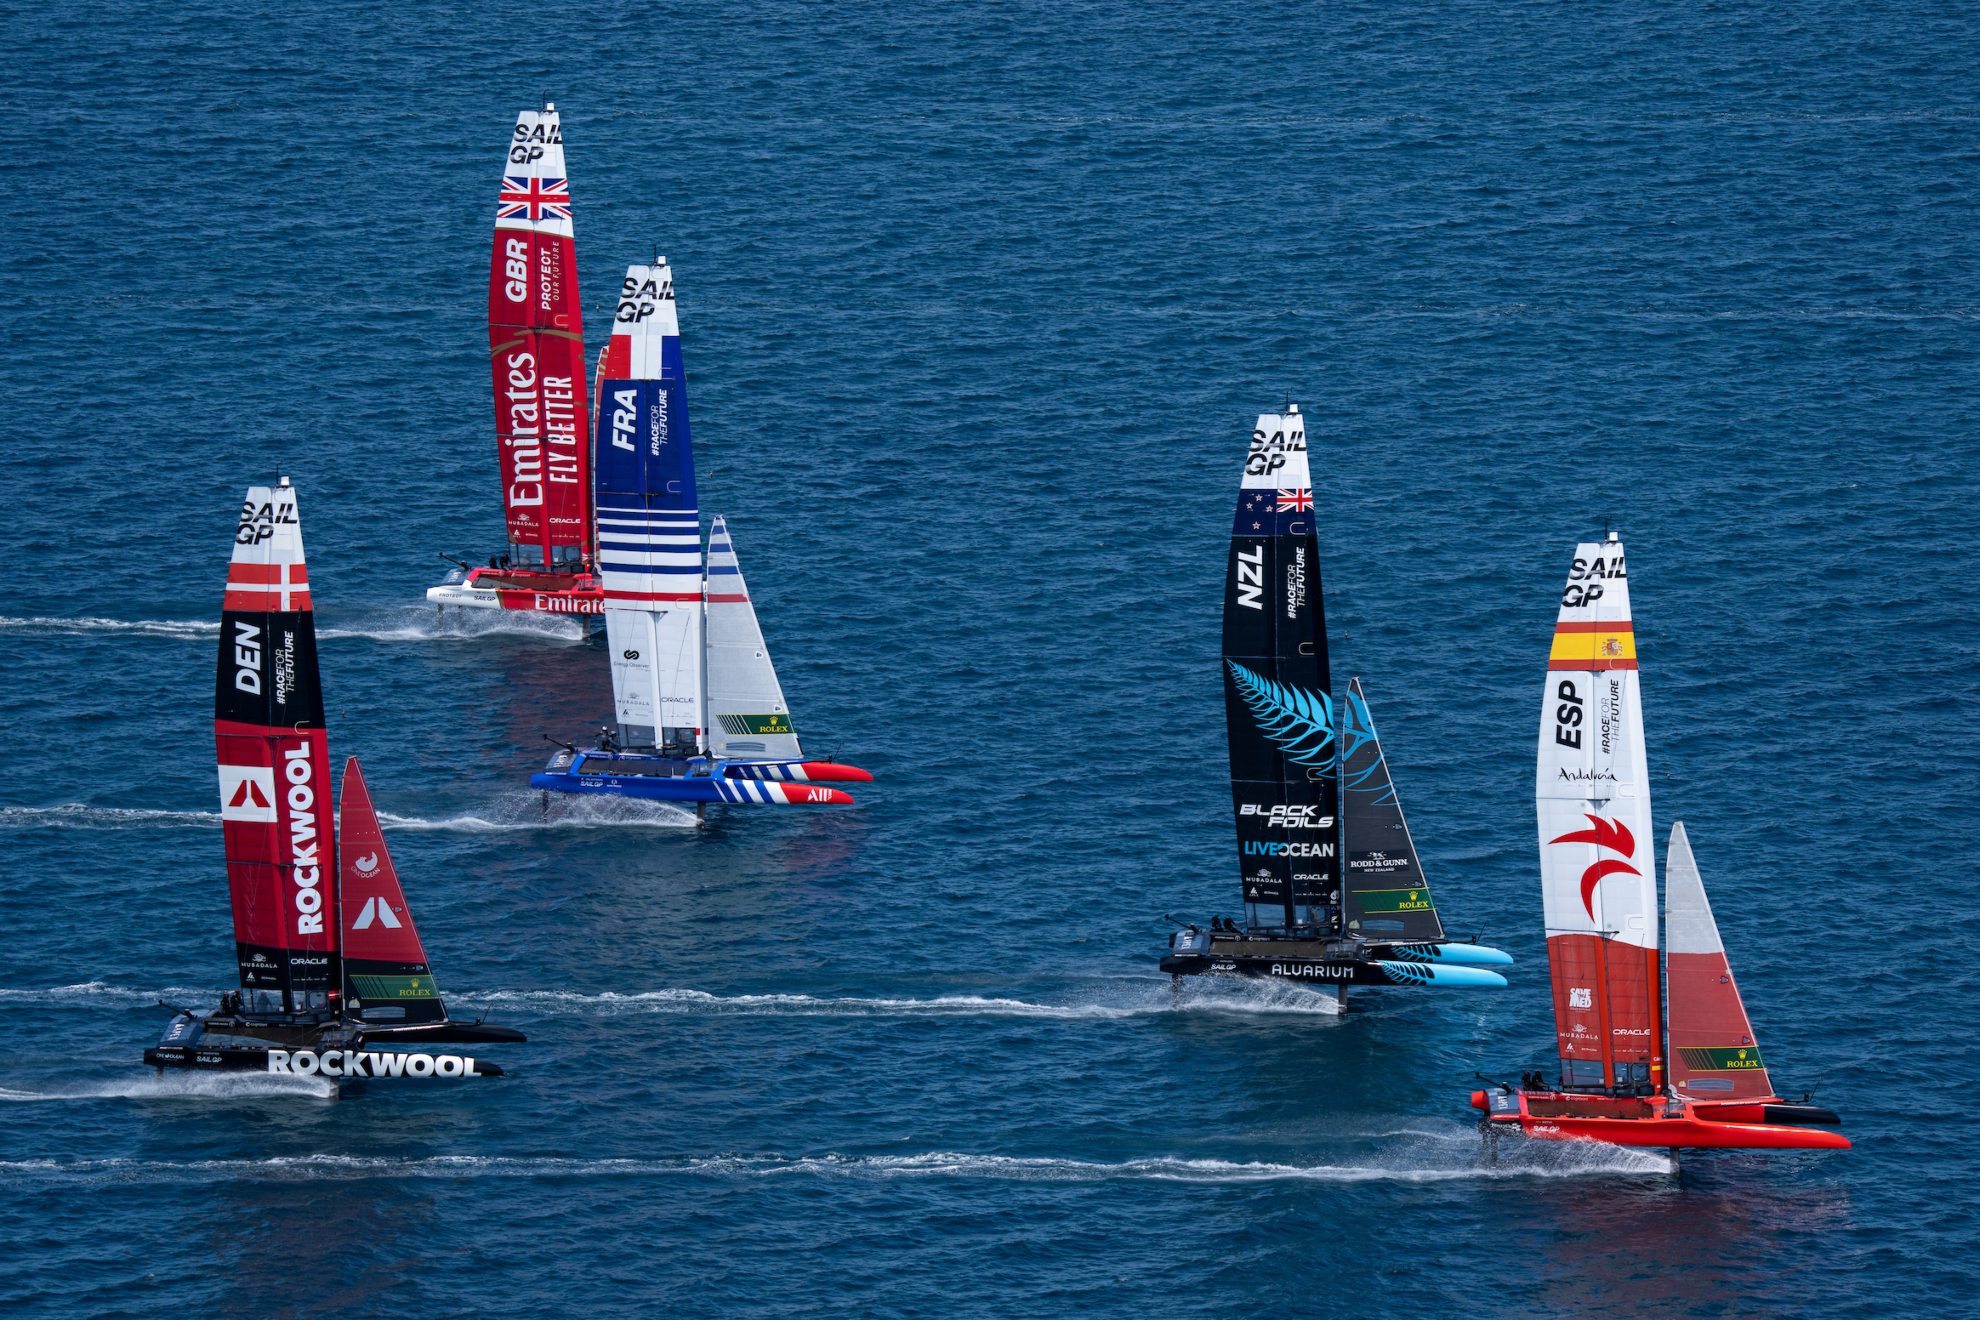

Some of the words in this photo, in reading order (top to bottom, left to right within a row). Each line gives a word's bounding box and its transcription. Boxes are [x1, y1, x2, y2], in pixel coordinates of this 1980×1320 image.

[514, 124, 563, 145] SAIL
[509, 145, 544, 164] GP
[505, 238, 528, 302] GBR
[541, 247, 552, 310] PROTECT
[620, 277, 675, 300] SAIL
[616, 301, 655, 323] GP
[543, 376, 576, 446] BETTER
[612, 389, 637, 452] FRA
[504, 352, 544, 509] Emirates
[1249, 429, 1307, 452] SAIL
[548, 451, 579, 484] FLY
[1245, 453, 1286, 476] GP
[240, 501, 298, 524] SAIL
[236, 523, 274, 545] GP
[1237, 545, 1263, 610] NZL
[1568, 557, 1627, 581] SAIL
[534, 593, 606, 614] Emirate
[1561, 584, 1604, 608] GP
[235, 621, 260, 695] DEN
[1555, 679, 1583, 750] ESP
[1240, 804, 1318, 816] BLACK
[1267, 816, 1334, 828] FOILS
[285, 741, 323, 935] ROCKWOOL
[1350, 860, 1375, 868] RODD
[1245, 876, 1282, 884] MUBADALA
[1293, 873, 1329, 881] ORACLE
[1399, 901, 1429, 909] ROLEX
[1569, 994, 1592, 1008] MED
[1570, 987, 1591, 998] SAVE
[1560, 1032, 1599, 1040] MUBADALA
[267, 1050, 482, 1077] ROCKWOOL
[1727, 1060, 1758, 1068] ROLEX
